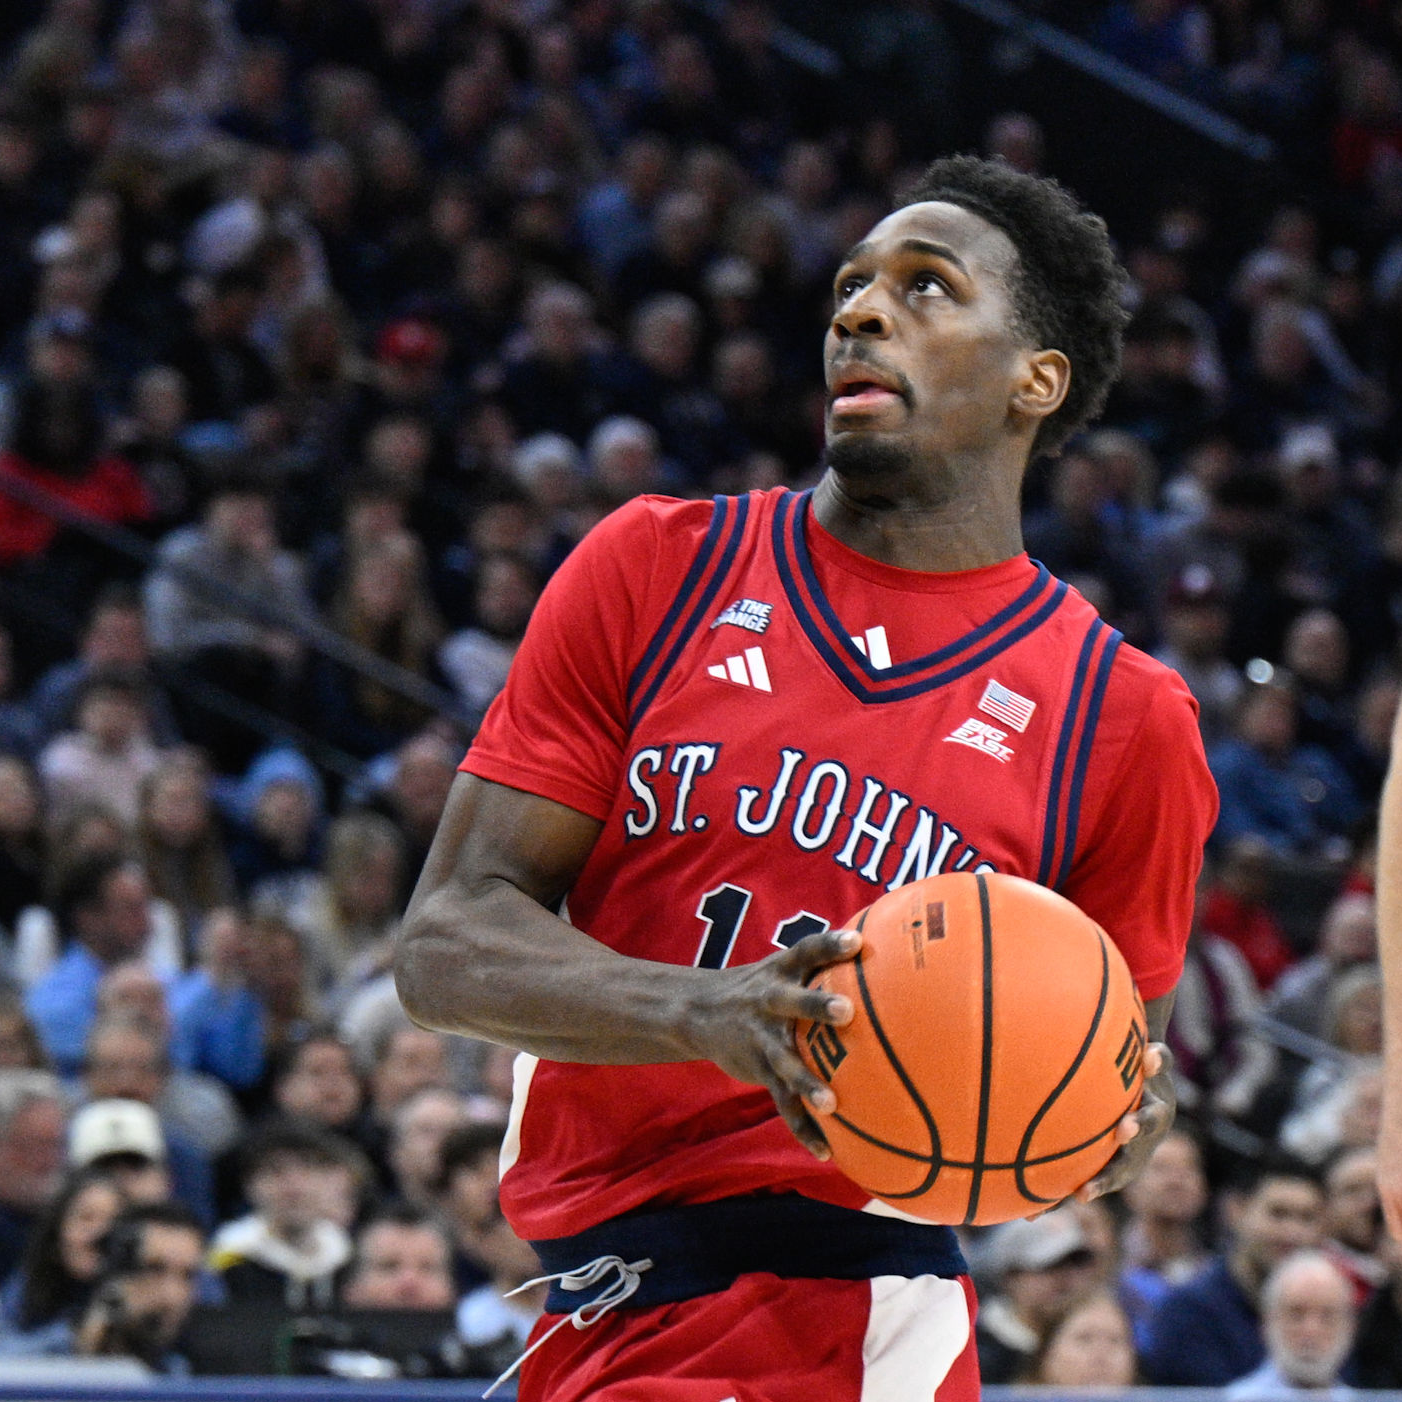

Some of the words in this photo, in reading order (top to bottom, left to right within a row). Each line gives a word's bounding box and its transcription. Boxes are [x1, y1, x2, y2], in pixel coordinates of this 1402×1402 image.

[950, 728, 1015, 761] EAST
[961, 717, 1009, 742] BIG
[625, 742, 724, 840] ST.
[735, 747, 999, 894] JOHN'
[692, 882, 832, 970] 1
